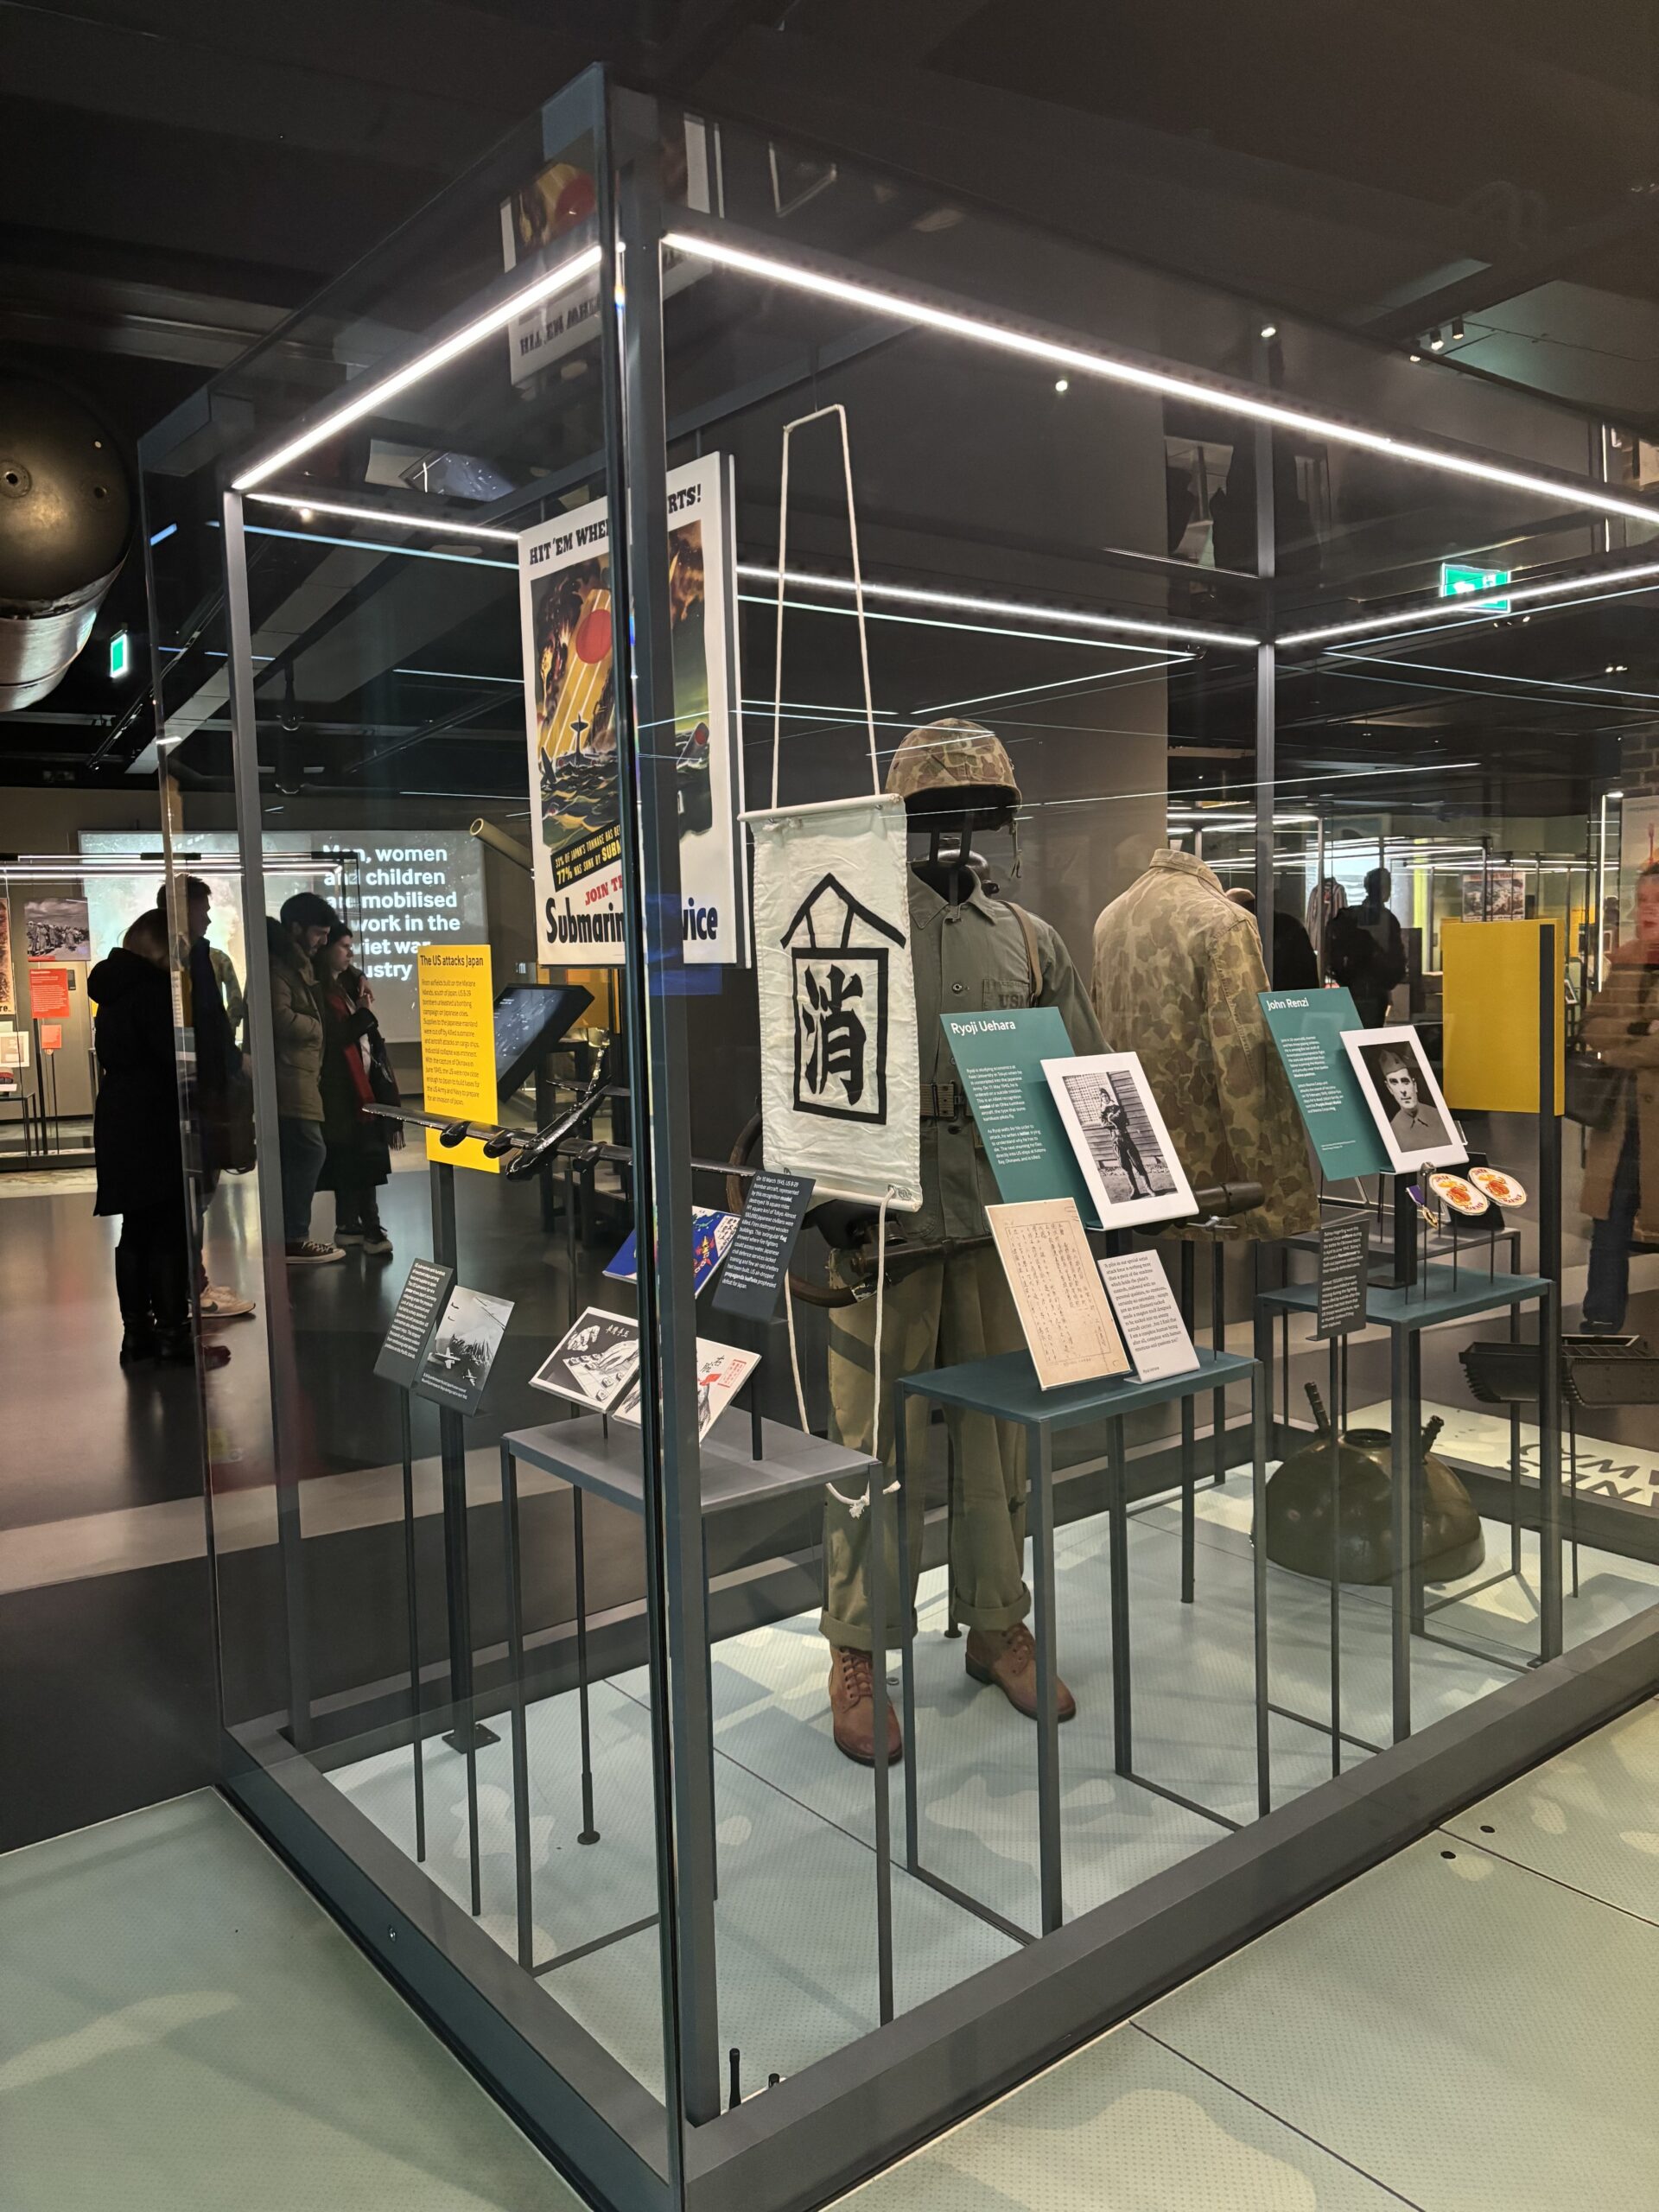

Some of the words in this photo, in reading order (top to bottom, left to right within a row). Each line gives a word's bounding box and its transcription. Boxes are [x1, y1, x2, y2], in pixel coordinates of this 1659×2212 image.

[530, 543, 551, 566] HIT
[552, 533, 574, 557] 'EM
[575, 518, 608, 545] WHE
[667, 484, 702, 514] RTS!
[587, 834, 604, 852] TONNAGE
[375, 849, 448, 861] women
[365, 868, 446, 886] children
[556, 866, 572, 885] 77%
[574, 864, 582, 876] WAS
[583, 857, 594, 872] SUNK
[595, 854, 601, 865] BY
[361, 892, 457, 909] mobilised
[585, 882, 609, 906] JOIN
[350, 915, 402, 932] work
[404, 915, 423, 931] in
[427, 915, 461, 931] the
[545, 897, 625, 944] Submarin
[683, 897, 718, 941] vice
[353, 938, 391, 955] viet
[420, 955, 432, 966] The
[433, 955, 442, 966] US
[442, 955, 465, 966] attacks
[466, 955, 484, 968] Japan
[365, 963, 413, 982] ustry
[998, 994, 1029, 1009] USM
[1266, 999, 1286, 1011] John
[1287, 997, 1309, 1009] Renzi
[803, 963, 867, 1106] 消
[950, 1020, 979, 1036] Ryoji
[979, 1020, 1016, 1032] Uehara
